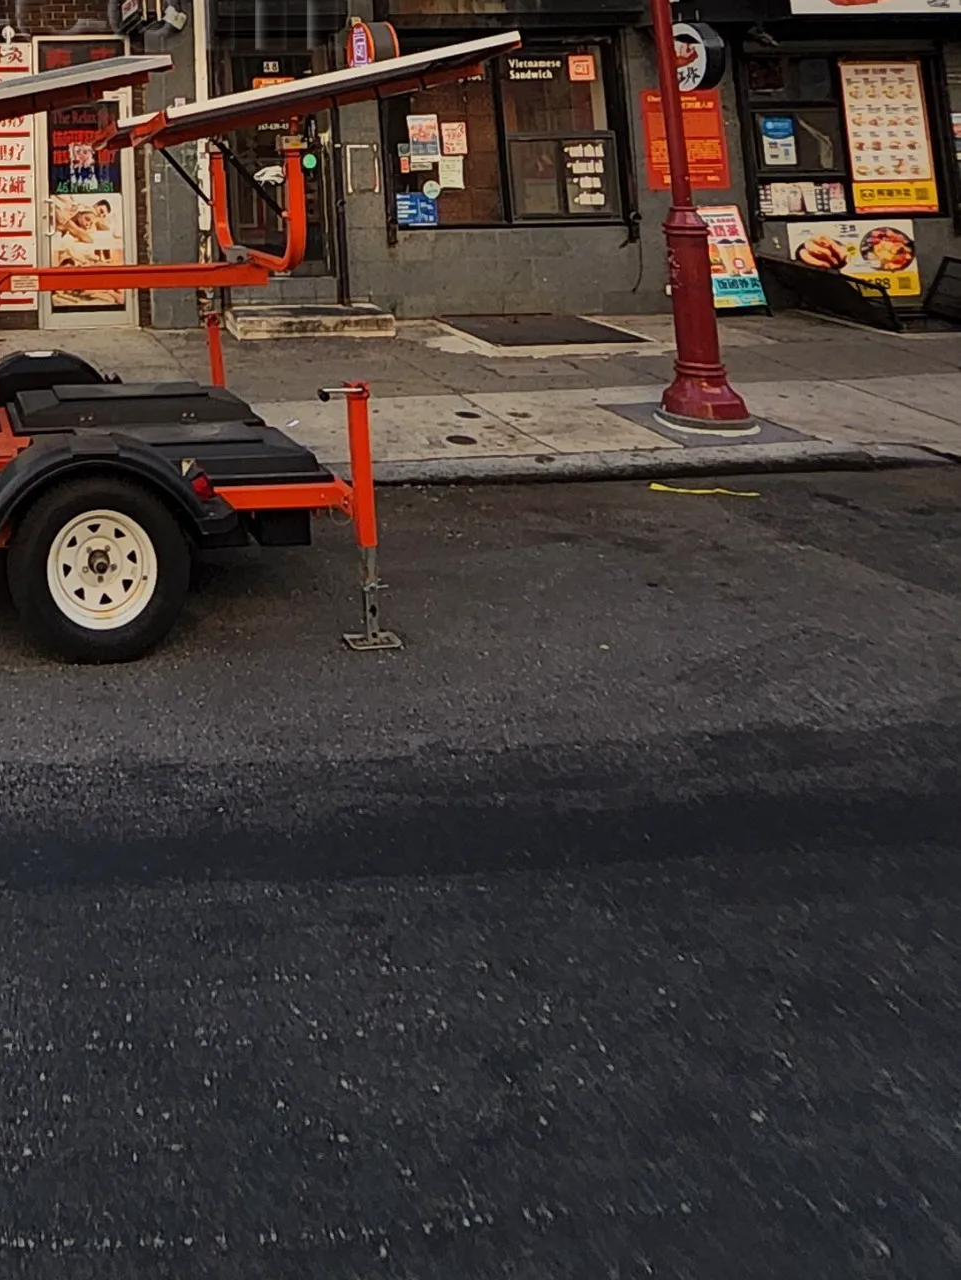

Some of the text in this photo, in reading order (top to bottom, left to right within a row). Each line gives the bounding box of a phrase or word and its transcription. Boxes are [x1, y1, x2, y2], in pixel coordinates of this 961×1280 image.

[264, 61, 279, 71] 48
[507, 58, 562, 68] Vietnamese
[509, 69, 553, 79] Sandwich
